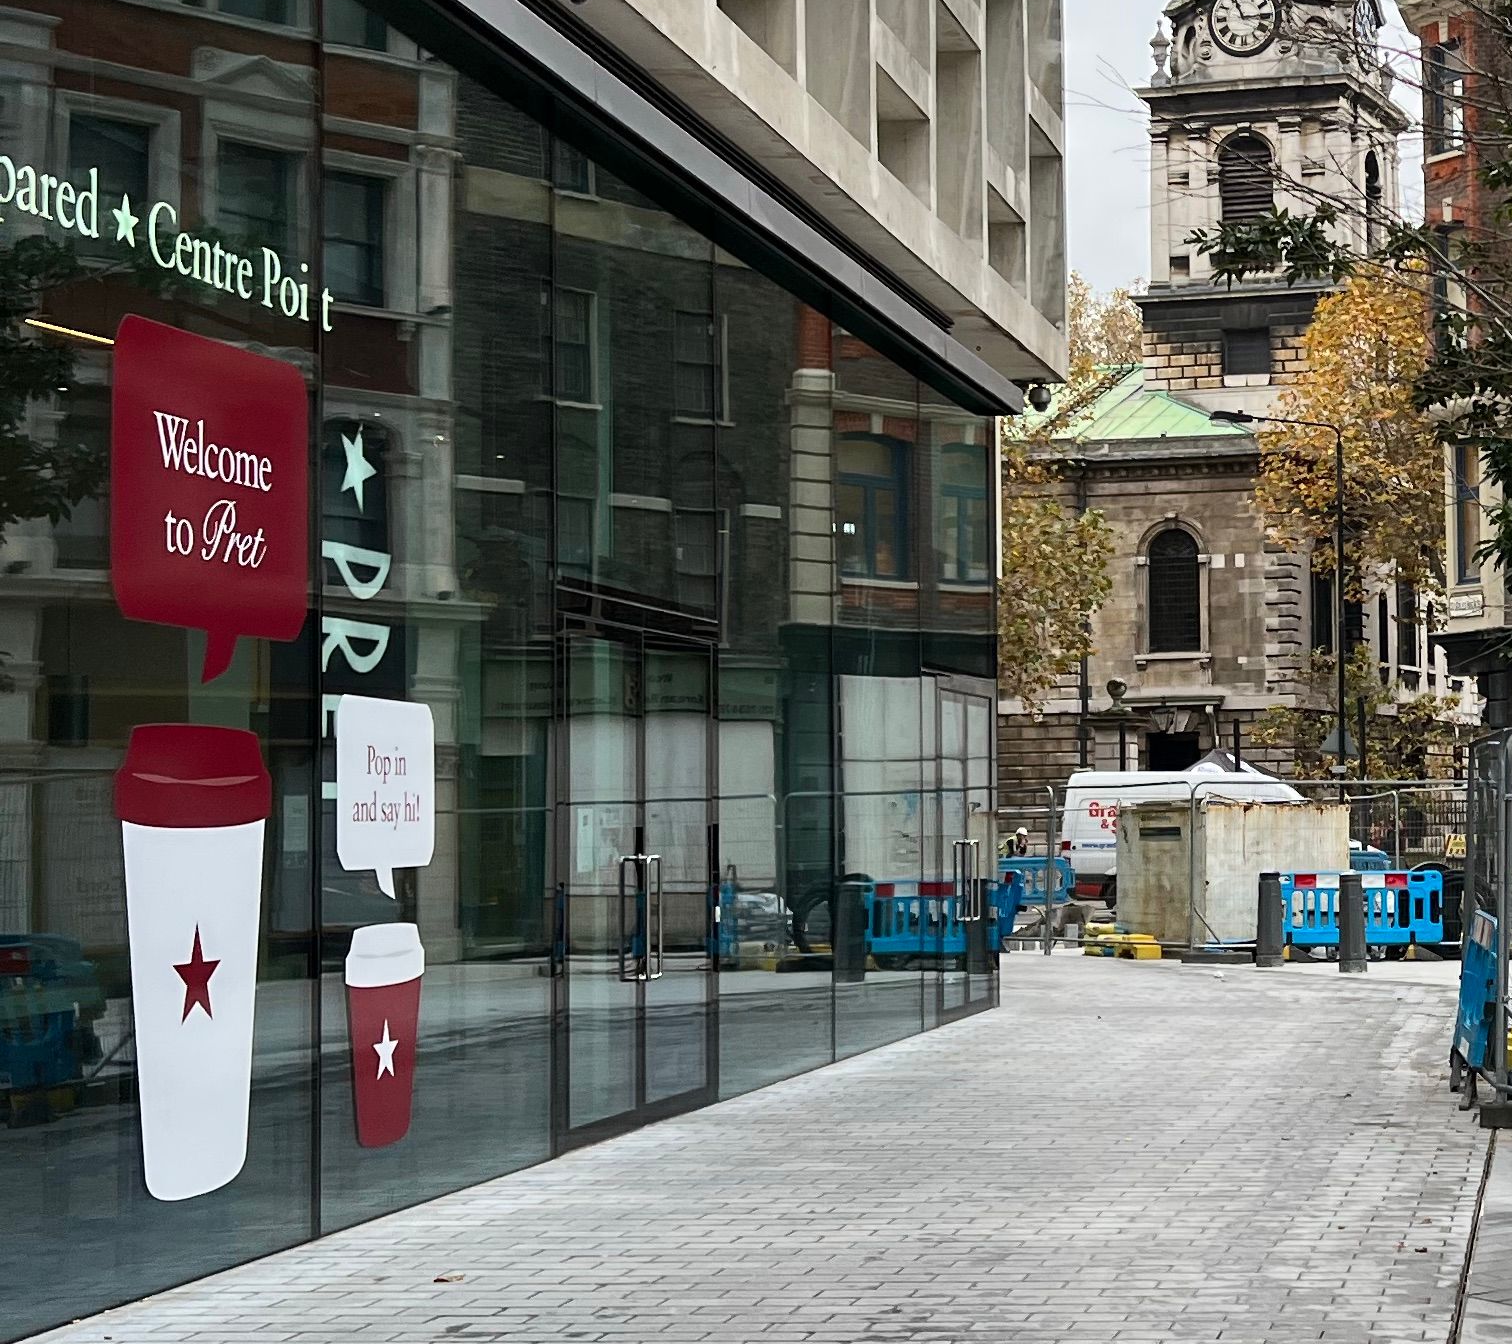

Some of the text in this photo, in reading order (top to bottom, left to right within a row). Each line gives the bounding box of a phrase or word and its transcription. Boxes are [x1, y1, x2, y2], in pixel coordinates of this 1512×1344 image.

[148, 201, 253, 300] Centre
[261, 247, 334, 332] Poit
[153, 411, 273, 492] Welcome
[165, 499, 268, 568] to Pret
[366, 745, 407, 785] Pop in
[352, 790, 420, 831] and say hi!
